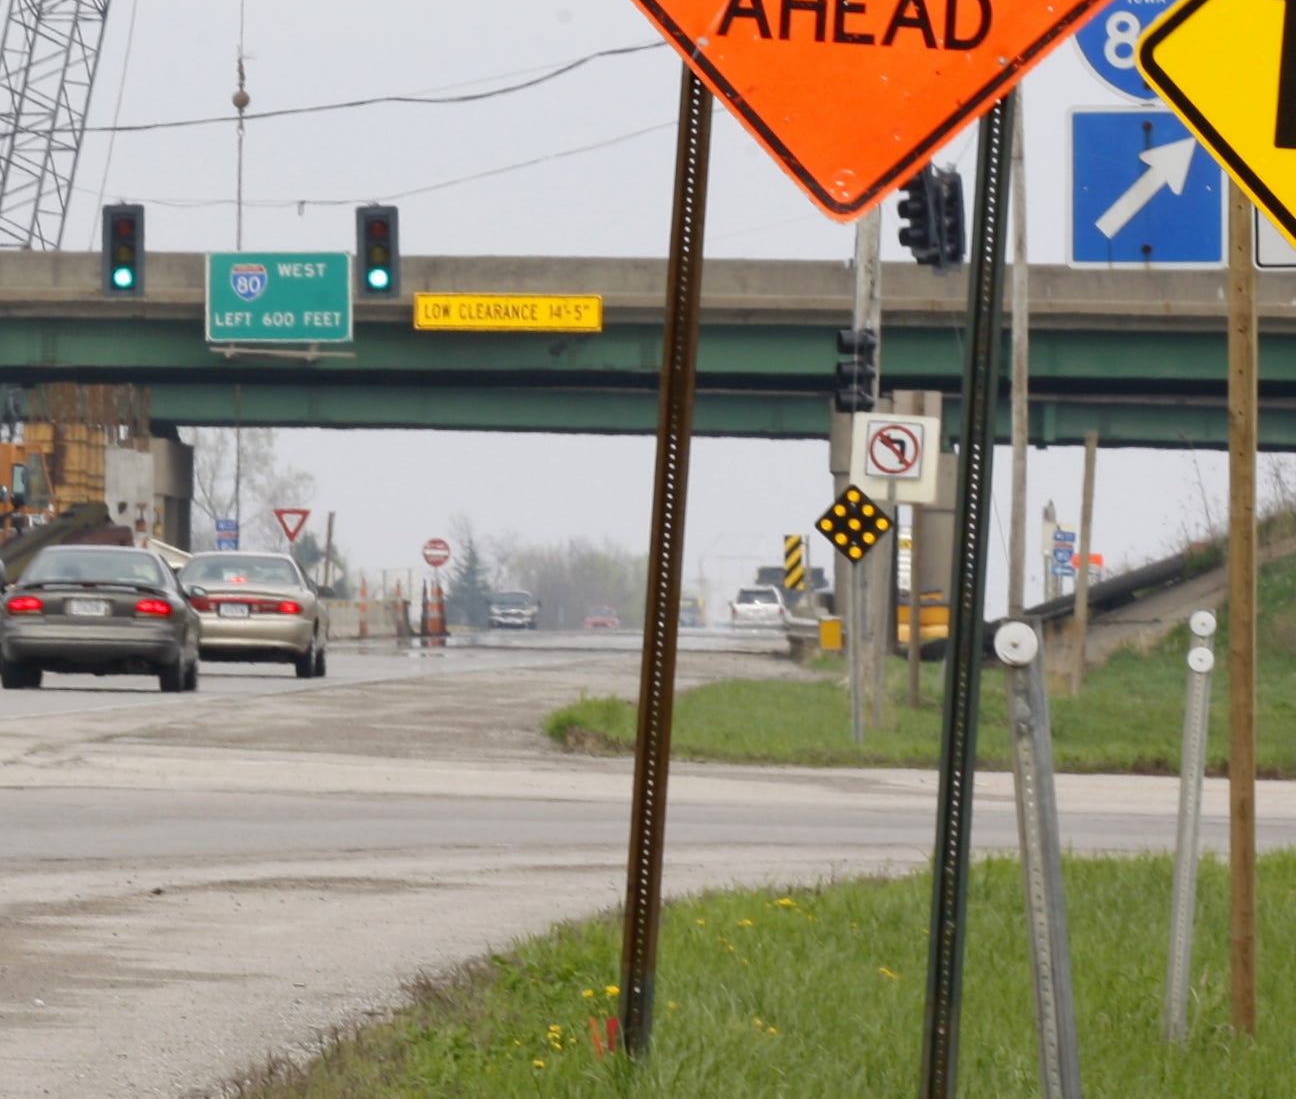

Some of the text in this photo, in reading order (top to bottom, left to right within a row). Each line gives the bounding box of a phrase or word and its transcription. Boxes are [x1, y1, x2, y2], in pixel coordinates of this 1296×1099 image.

[276, 262, 328, 278] WEST
[236, 275, 261, 295] 80
[215, 311, 342, 327] LEFT 600 FEET
[424, 303, 451, 319] LOW
[459, 303, 538, 321] CLEARANCE
